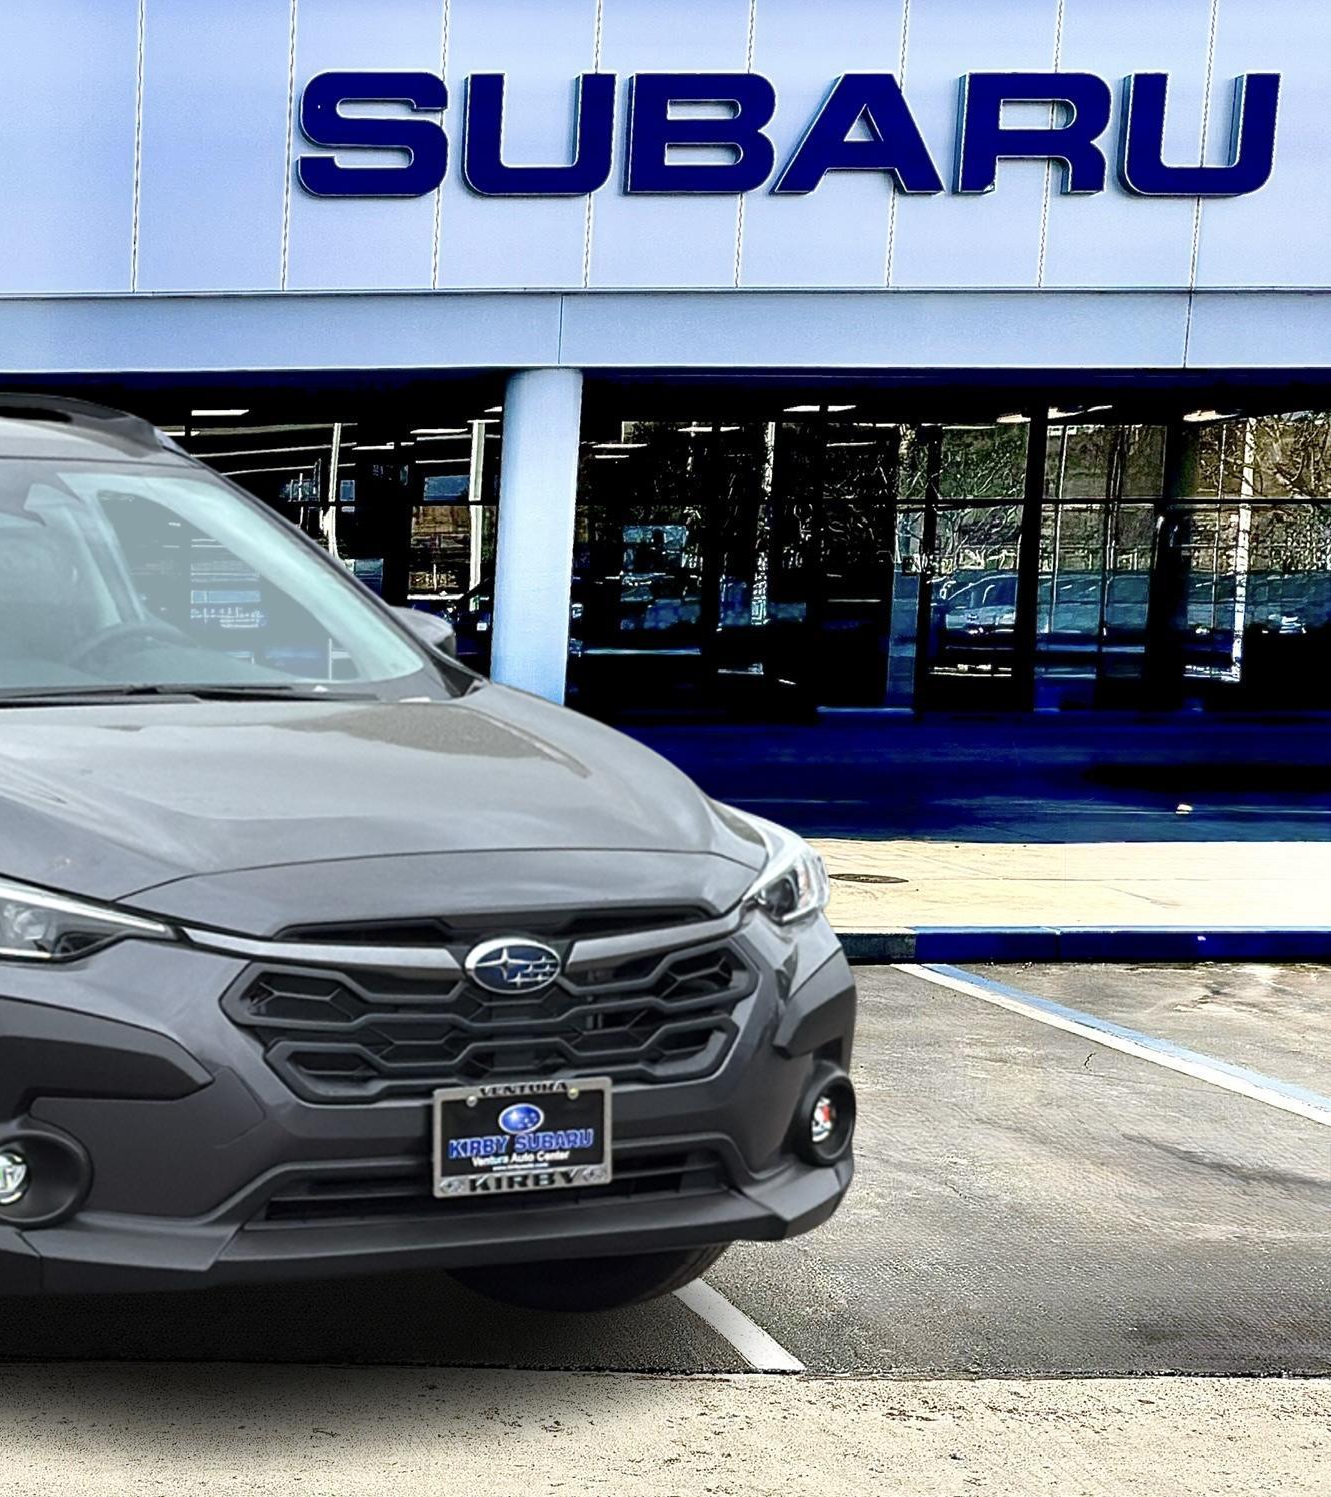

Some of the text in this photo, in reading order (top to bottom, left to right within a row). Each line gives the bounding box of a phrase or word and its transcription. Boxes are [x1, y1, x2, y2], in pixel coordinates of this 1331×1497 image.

[297, 70, 1282, 198] SUBARU
[480, 1081, 568, 1097] VENTURA
[449, 1129, 594, 1159] KIRBY SUBARU
[471, 1155, 509, 1167] Ventura
[510, 1152, 534, 1163] Auto
[536, 1150, 570, 1161] Center
[470, 1171, 578, 1192] KIRBY
